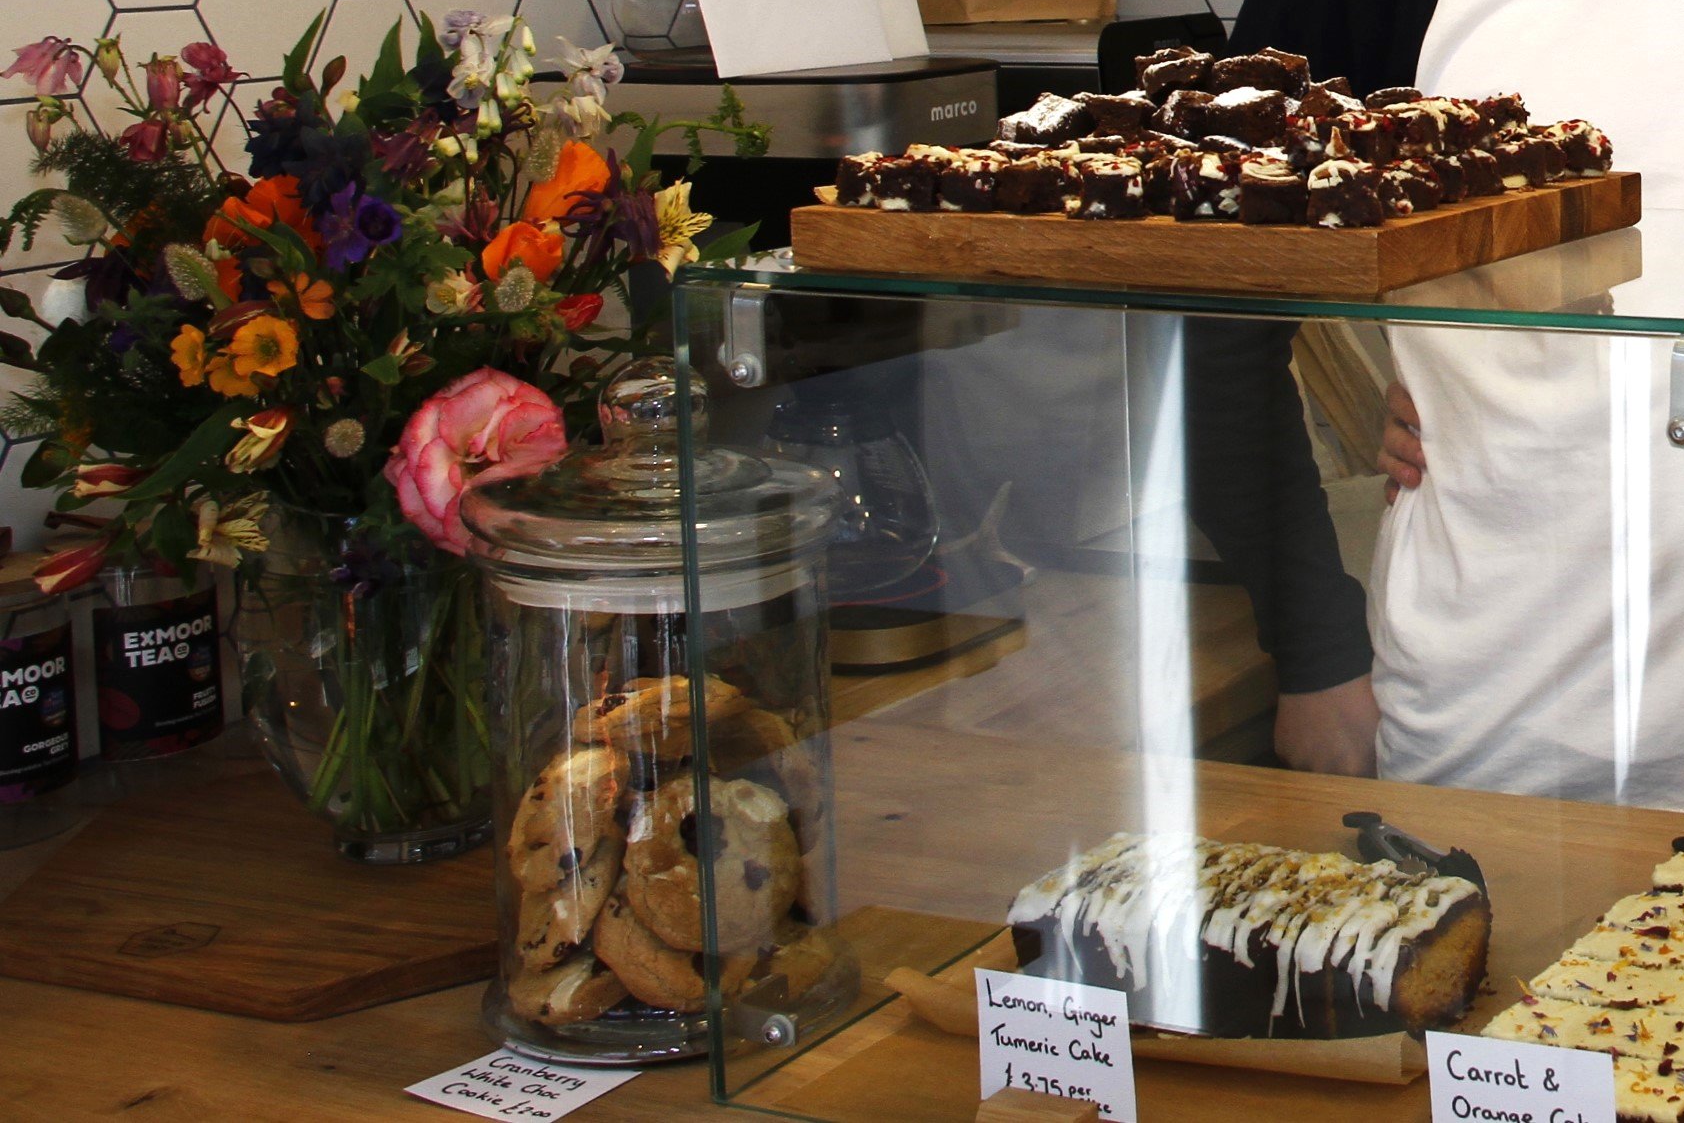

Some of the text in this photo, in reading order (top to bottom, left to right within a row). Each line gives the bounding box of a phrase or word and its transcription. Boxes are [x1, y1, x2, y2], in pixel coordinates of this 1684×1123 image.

[931, 100, 977, 121] marco
[124, 614, 213, 649] EXMOOR
[0, 656, 66, 688] MOOR
[124, 646, 175, 668] TEA
[1063, 996, 1117, 1038] Ginger
[990, 1023, 1113, 1067] Tumeric Cake
[461, 1068, 561, 1100] White Choc
[489, 1056, 588, 1092] Cranberry
[1446, 1050, 1560, 1092] Carrot &
[441, 1082, 504, 1106] Cookie
[1068, 1085, 1092, 1098] per
[1452, 1095, 1533, 1123] Orange
